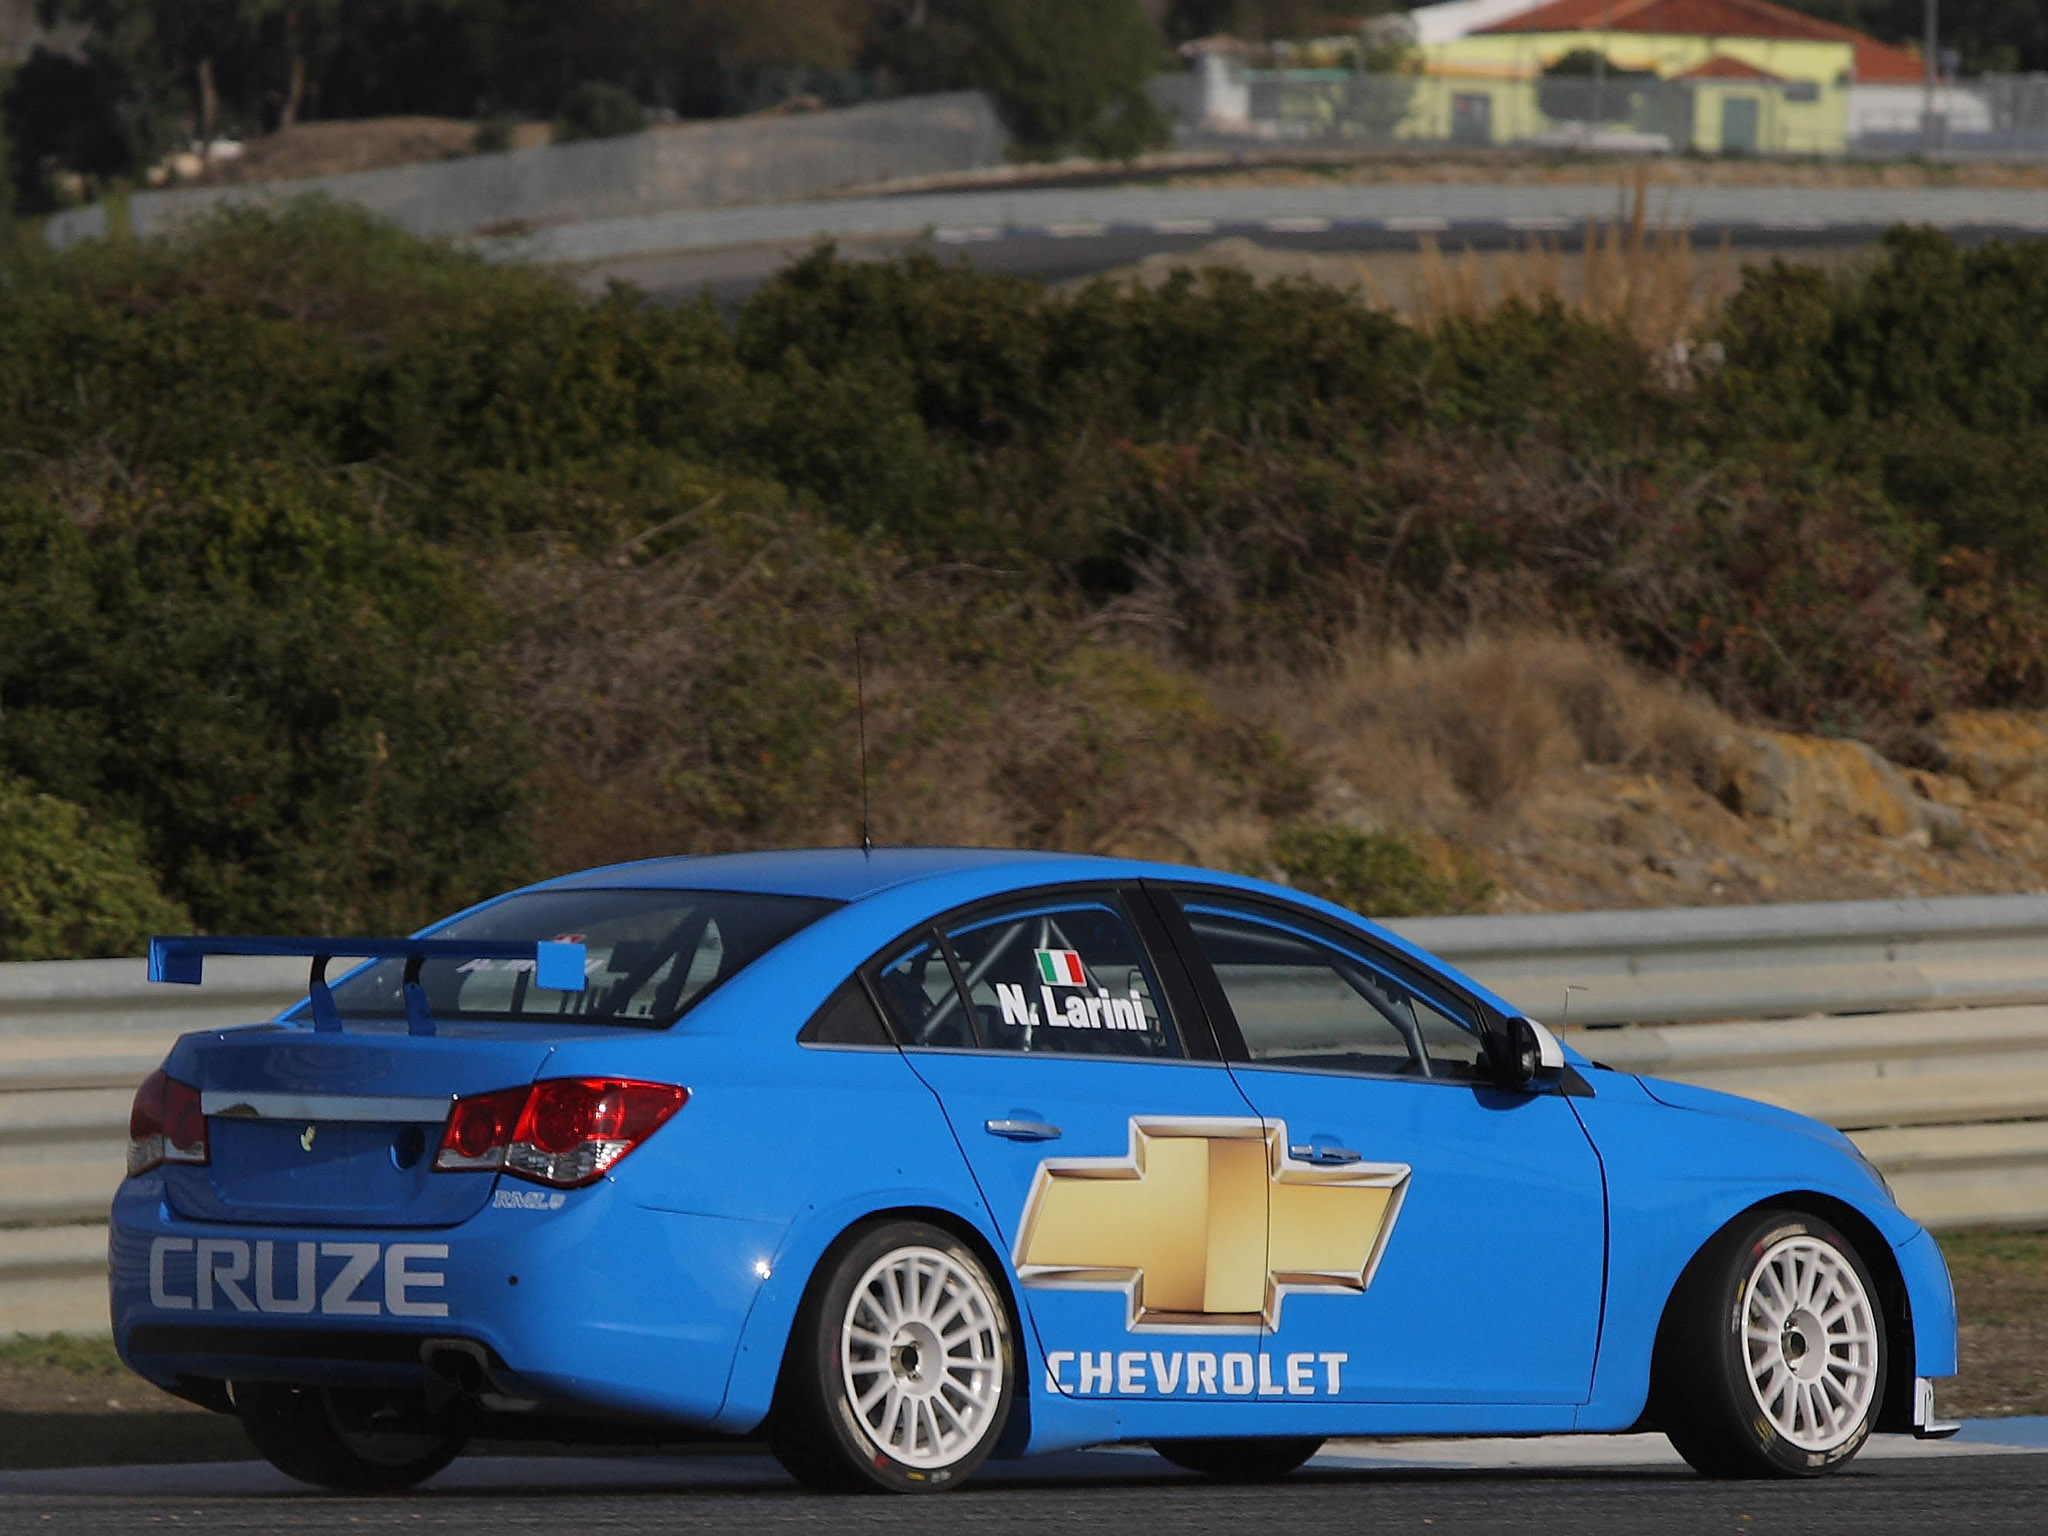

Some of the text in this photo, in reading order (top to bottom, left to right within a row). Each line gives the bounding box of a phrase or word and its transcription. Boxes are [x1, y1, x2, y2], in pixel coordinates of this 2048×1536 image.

[996, 983, 1148, 1031] N. Larini
[149, 1237, 448, 1317] CRUZE
[1045, 1351, 1348, 1395] CHEVROLET
